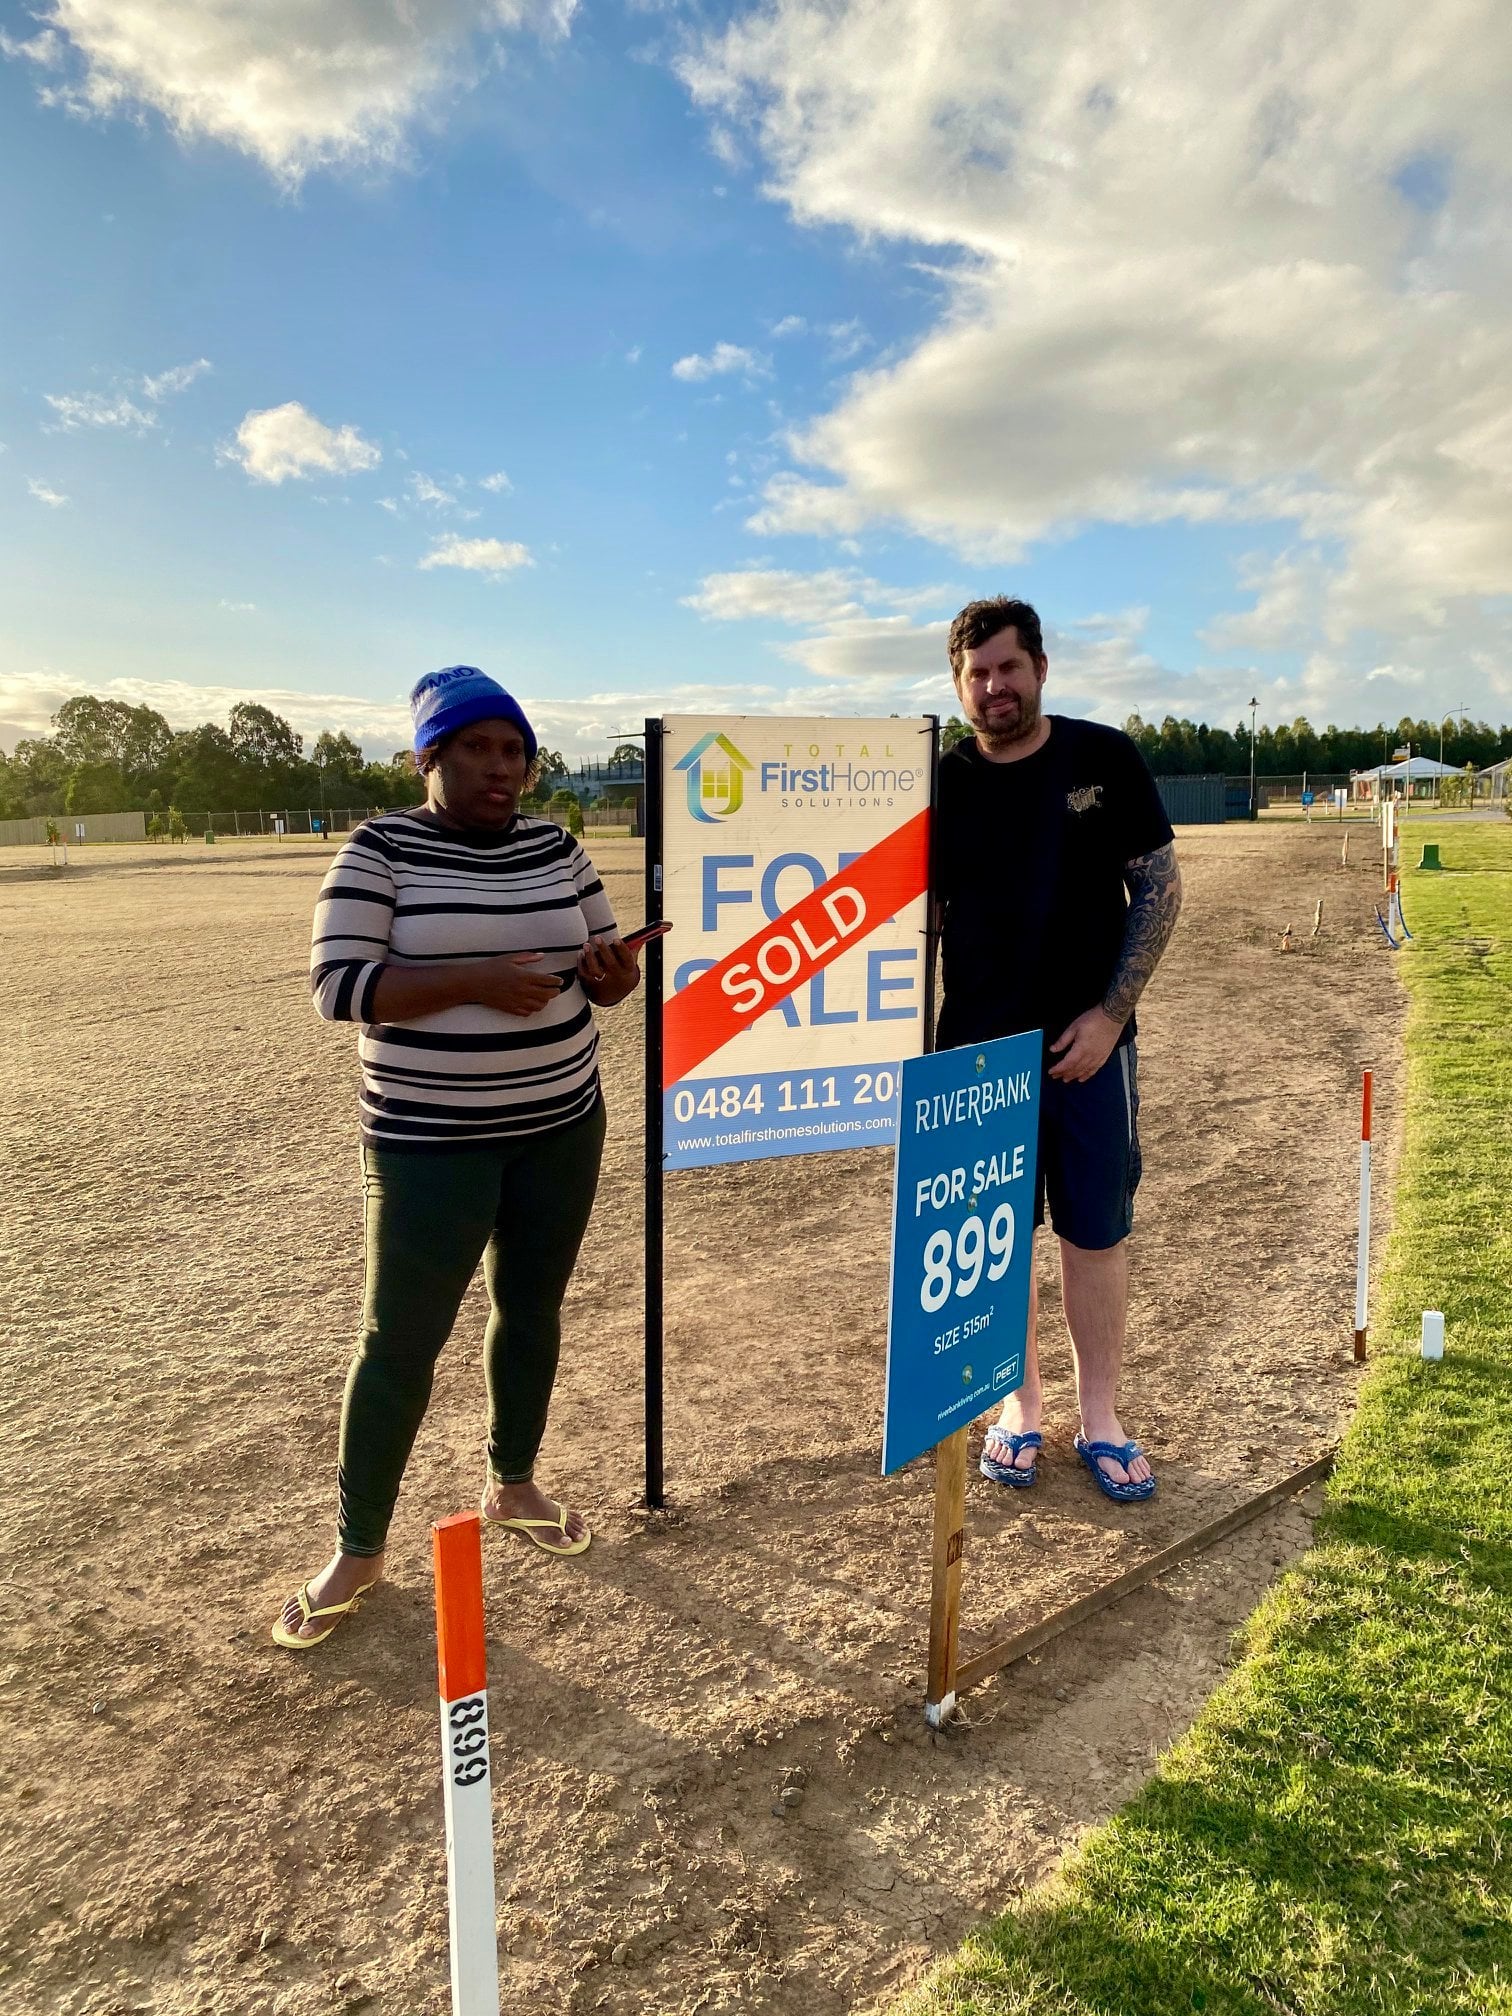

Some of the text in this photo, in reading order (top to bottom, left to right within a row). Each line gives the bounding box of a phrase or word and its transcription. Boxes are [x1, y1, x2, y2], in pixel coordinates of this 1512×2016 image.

[783, 744, 894, 758] TOTAL
[781, 797, 894, 808] SOLUTIONS
[702, 851, 897, 932] FO
[720, 886, 867, 1014] SOLD
[673, 1071, 899, 1123] 0484 111 20
[915, 1070, 1031, 1134] RIVERBANK
[677, 1116, 898, 1151] www.totalfirsthomesolutions.com.
[915, 1144, 1025, 1217] FOR SALE
[920, 1202, 1015, 1313] 899
[934, 1326, 960, 1355] SIZE
[995, 1361, 1017, 1384] PEET
[450, 1698, 488, 1787] 899
